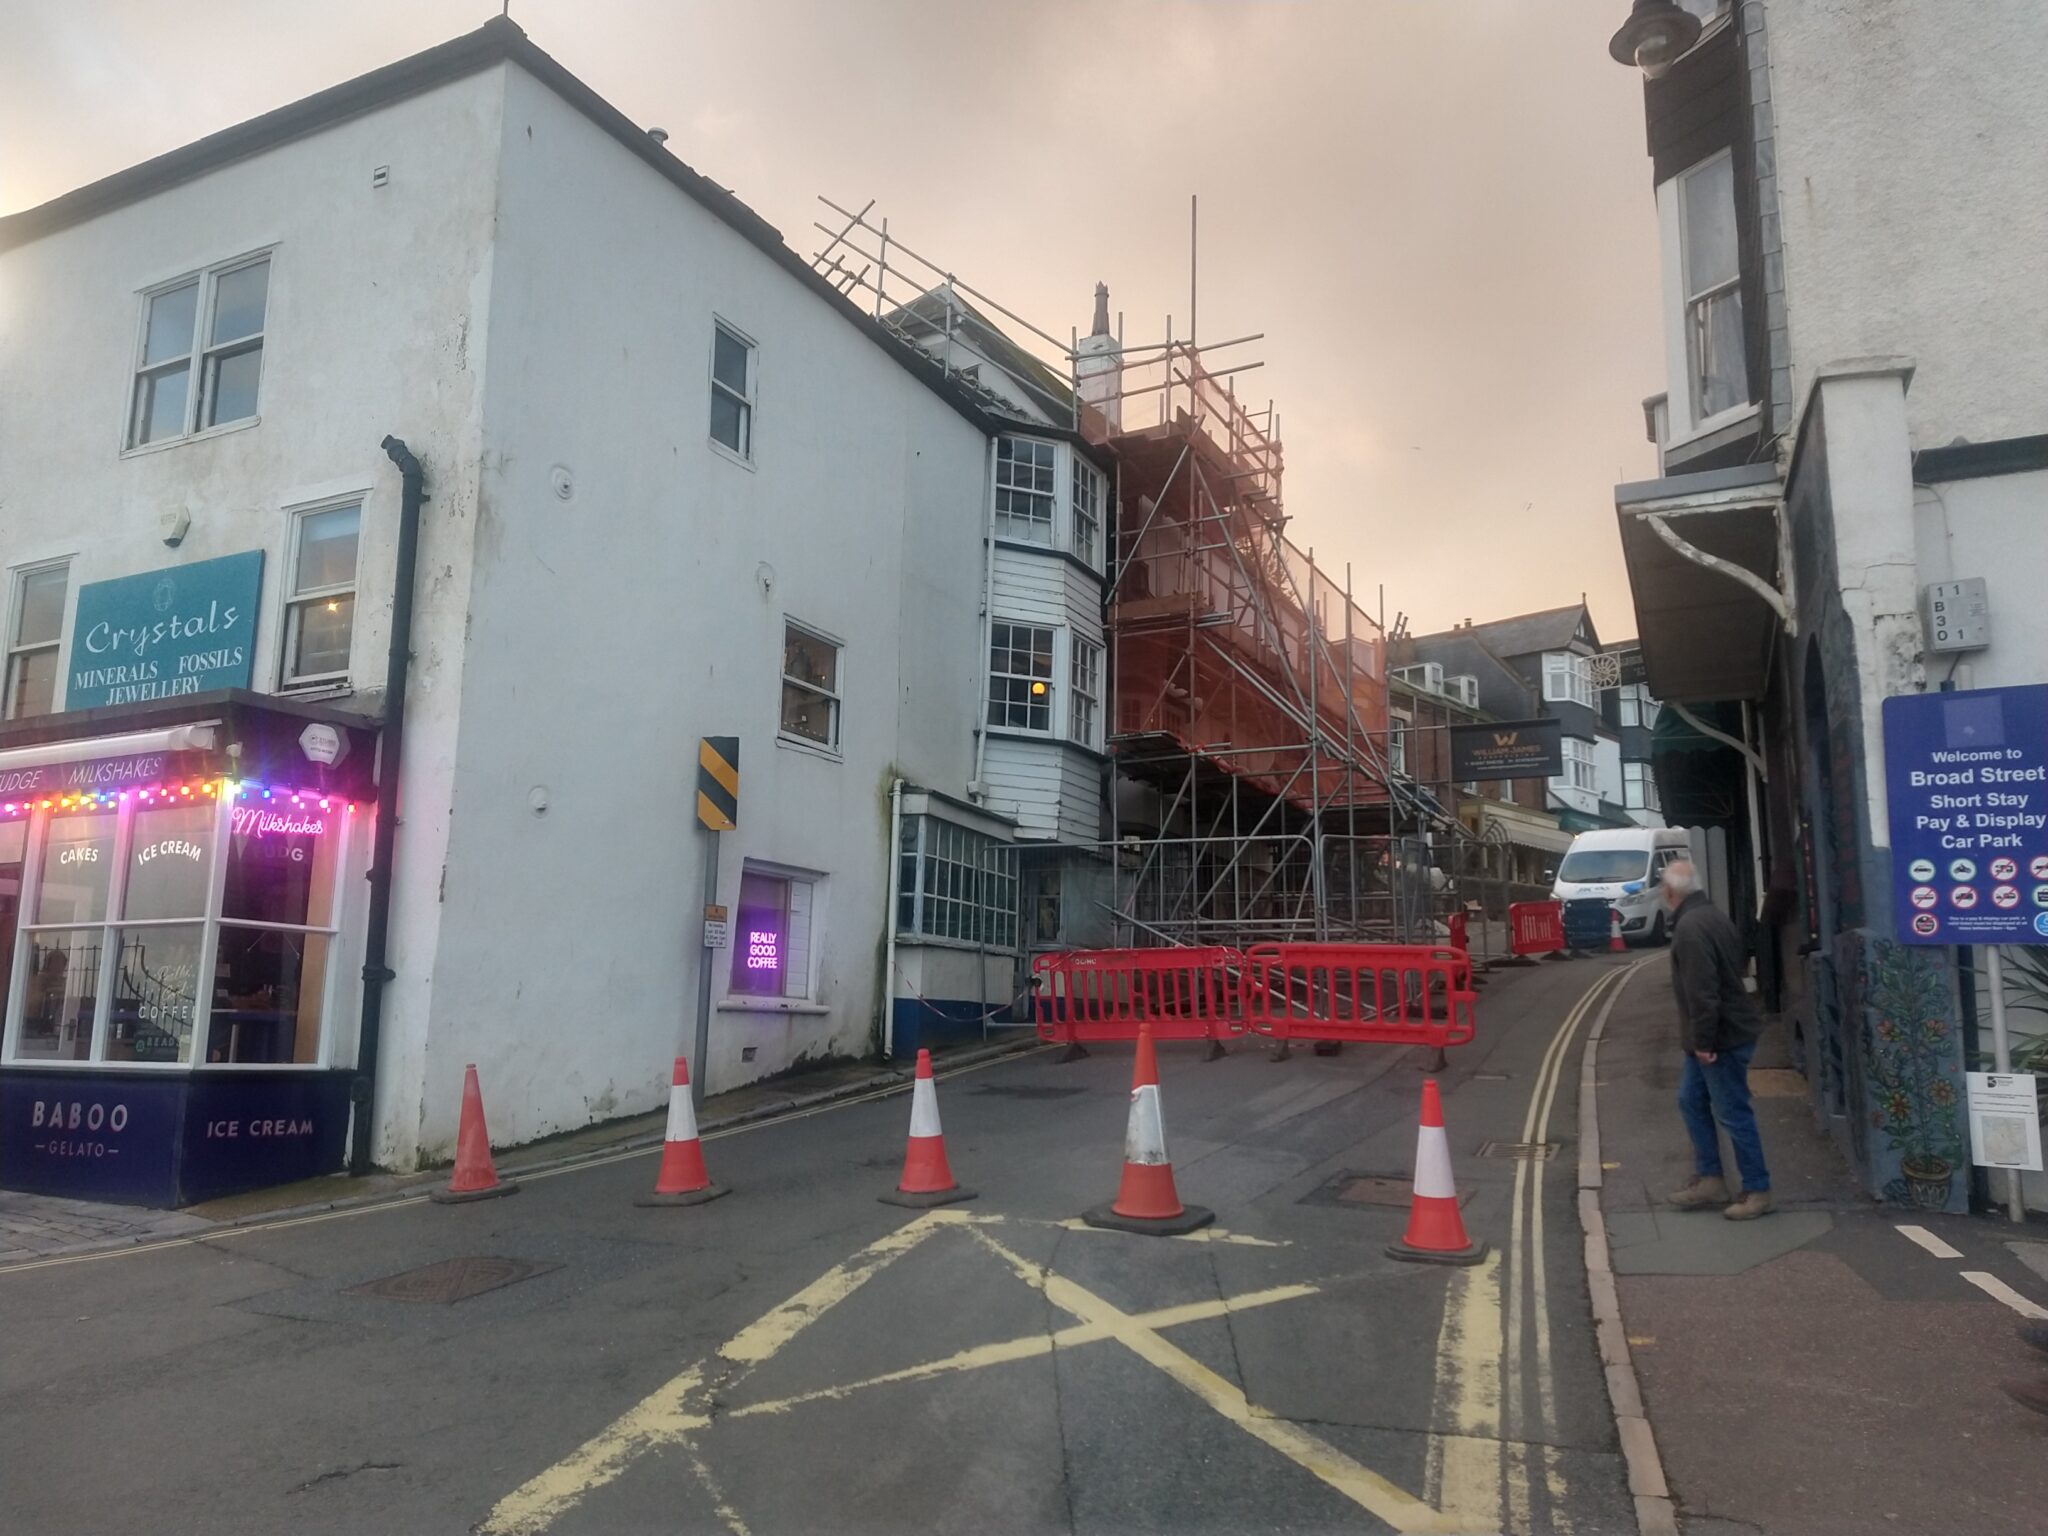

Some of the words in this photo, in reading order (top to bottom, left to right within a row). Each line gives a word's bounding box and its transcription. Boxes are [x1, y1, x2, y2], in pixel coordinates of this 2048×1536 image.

[86, 600, 239, 656] Crystals
[75, 660, 158, 690] MINERALS
[179, 646, 243, 674] FOSSILS
[106, 674, 203, 706] JEWELLERY
[1932, 750, 2002, 763] Welcome
[2006, 749, 2022, 761] to
[68, 757, 162, 785] MILKSHAKES
[1910, 769, 1974, 786] Broad
[1981, 766, 2045, 783] Street
[1931, 793, 1981, 809] Short
[1987, 792, 2029, 809] Stay
[232, 806, 324, 838] Milkshakes
[1916, 815, 1950, 832] Pay
[1956, 814, 1970, 828] &
[1976, 812, 2046, 829] Display
[1941, 834, 1974, 849] Car
[1980, 833, 2023, 848] Park
[60, 847, 98, 865] CAKES
[138, 844, 157, 866] ICE
[160, 840, 202, 862] CREAM
[750, 931, 777, 944] REALLY
[750, 945, 776, 956] GOOD
[747, 957, 777, 968] COFFEE
[32, 1101, 128, 1132] BABOO
[207, 1121, 239, 1138] ICE
[250, 1120, 313, 1136] CREAM
